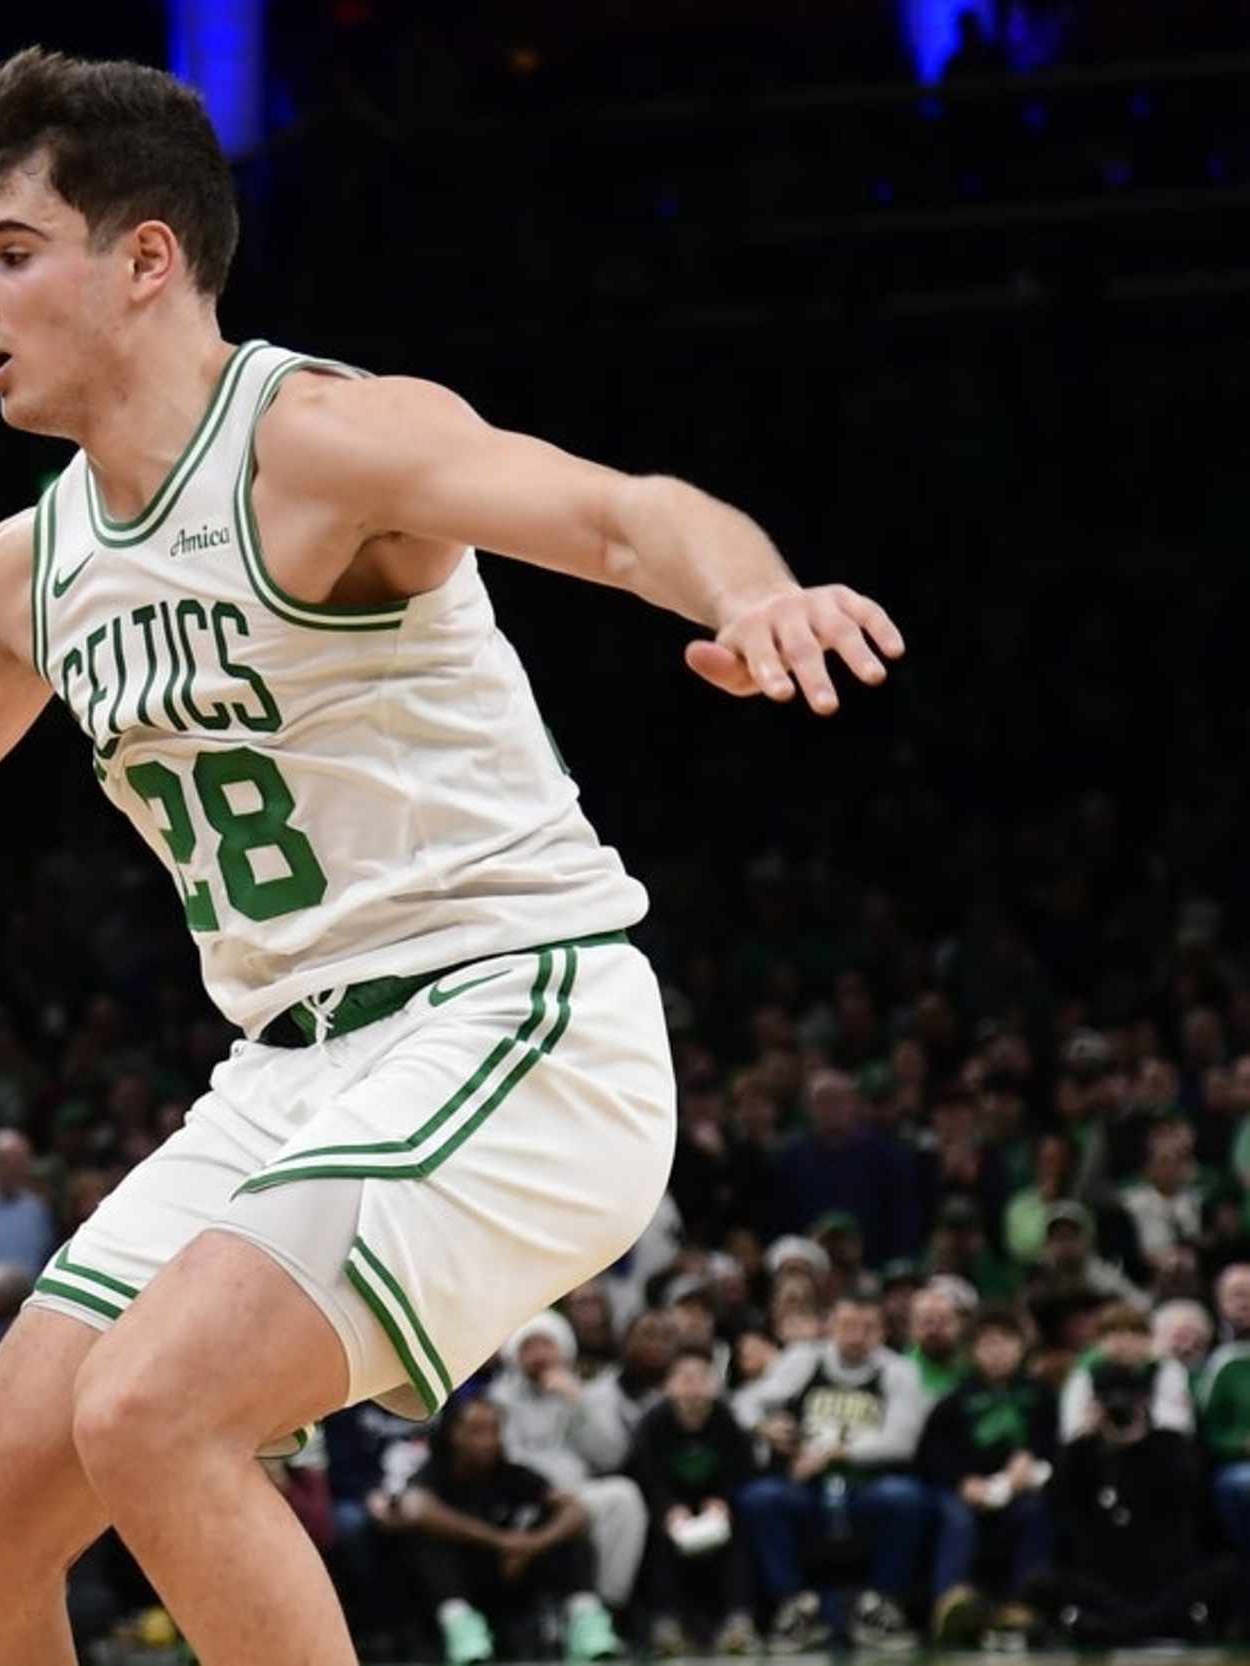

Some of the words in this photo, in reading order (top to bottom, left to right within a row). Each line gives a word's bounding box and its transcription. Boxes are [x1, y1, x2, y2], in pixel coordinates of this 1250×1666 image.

[170, 524, 230, 557] Amica
[62, 599, 283, 781] CELTICS
[125, 746, 328, 932] 28
